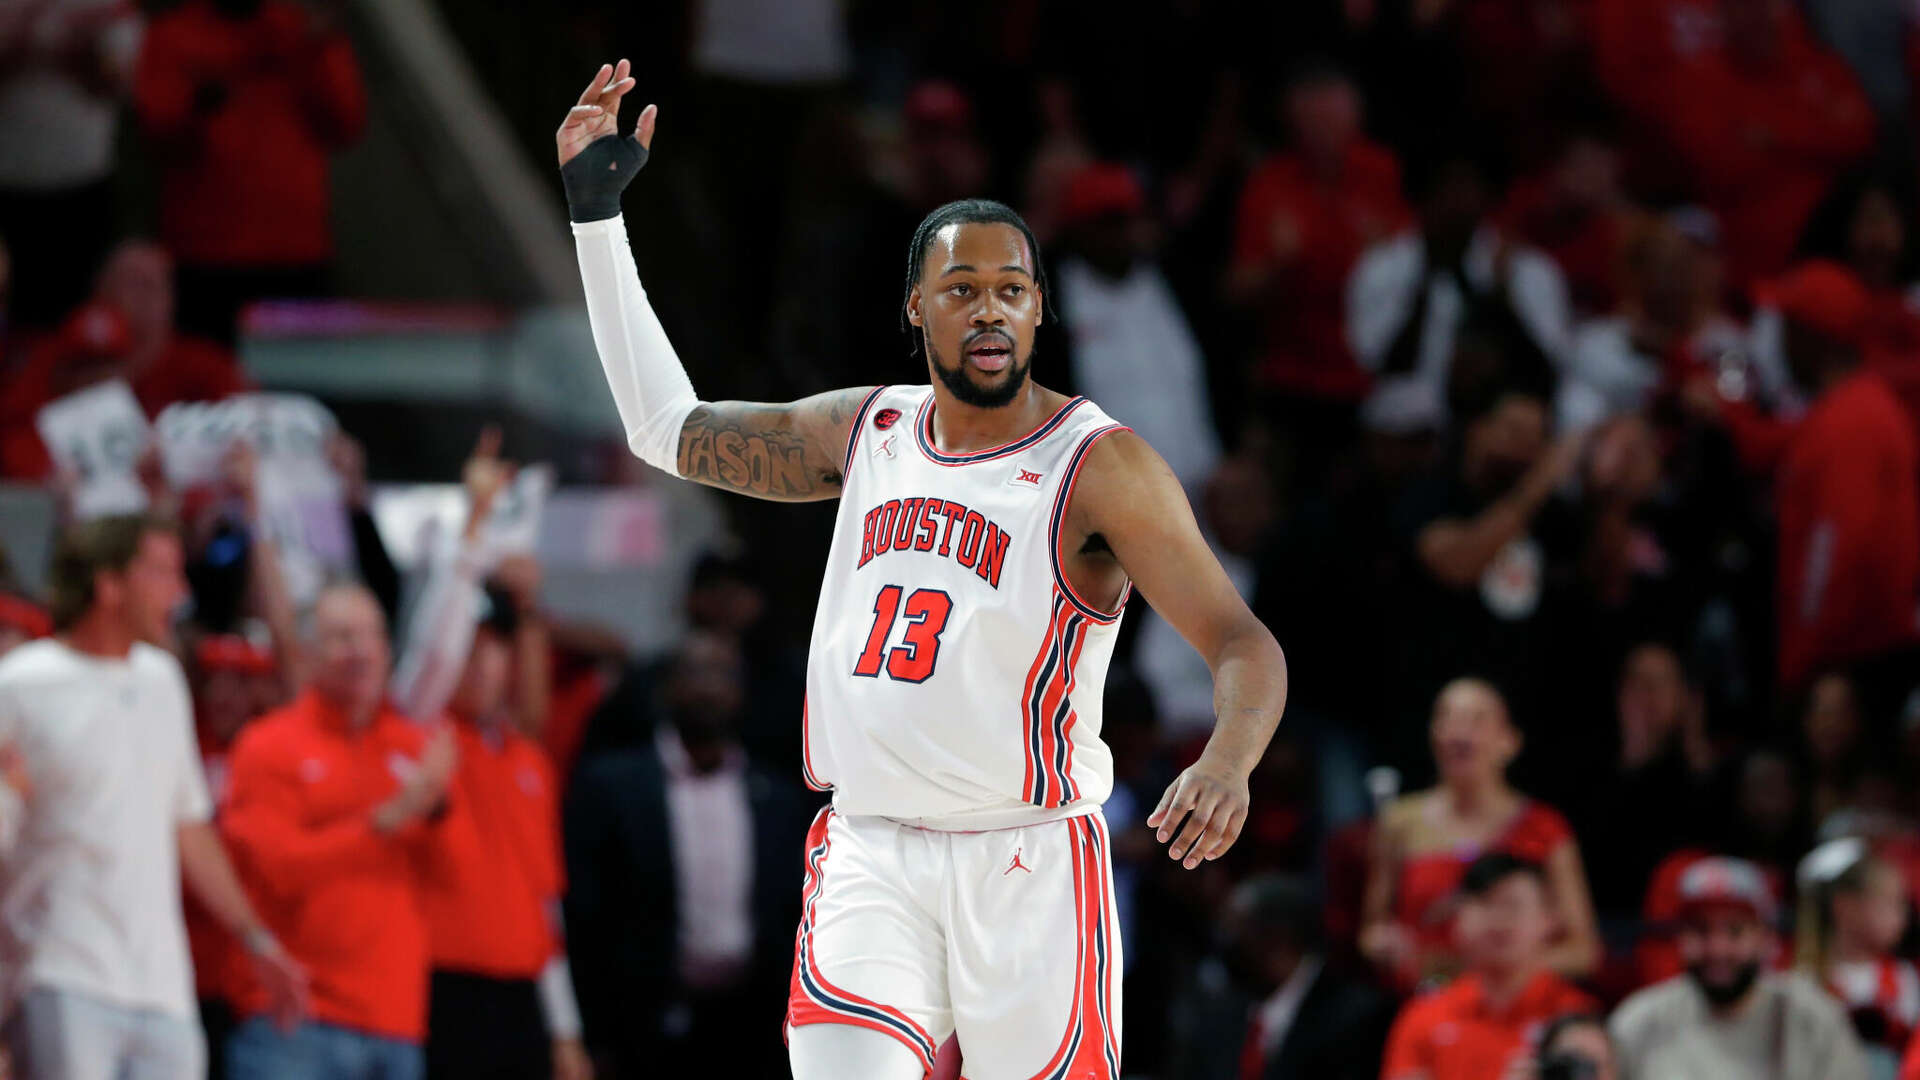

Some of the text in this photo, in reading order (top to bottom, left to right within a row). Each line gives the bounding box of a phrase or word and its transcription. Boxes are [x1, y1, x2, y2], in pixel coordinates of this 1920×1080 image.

[1016, 468, 1043, 485] XII
[857, 497, 1012, 591] HOUSTON
[853, 584, 954, 684] 13
